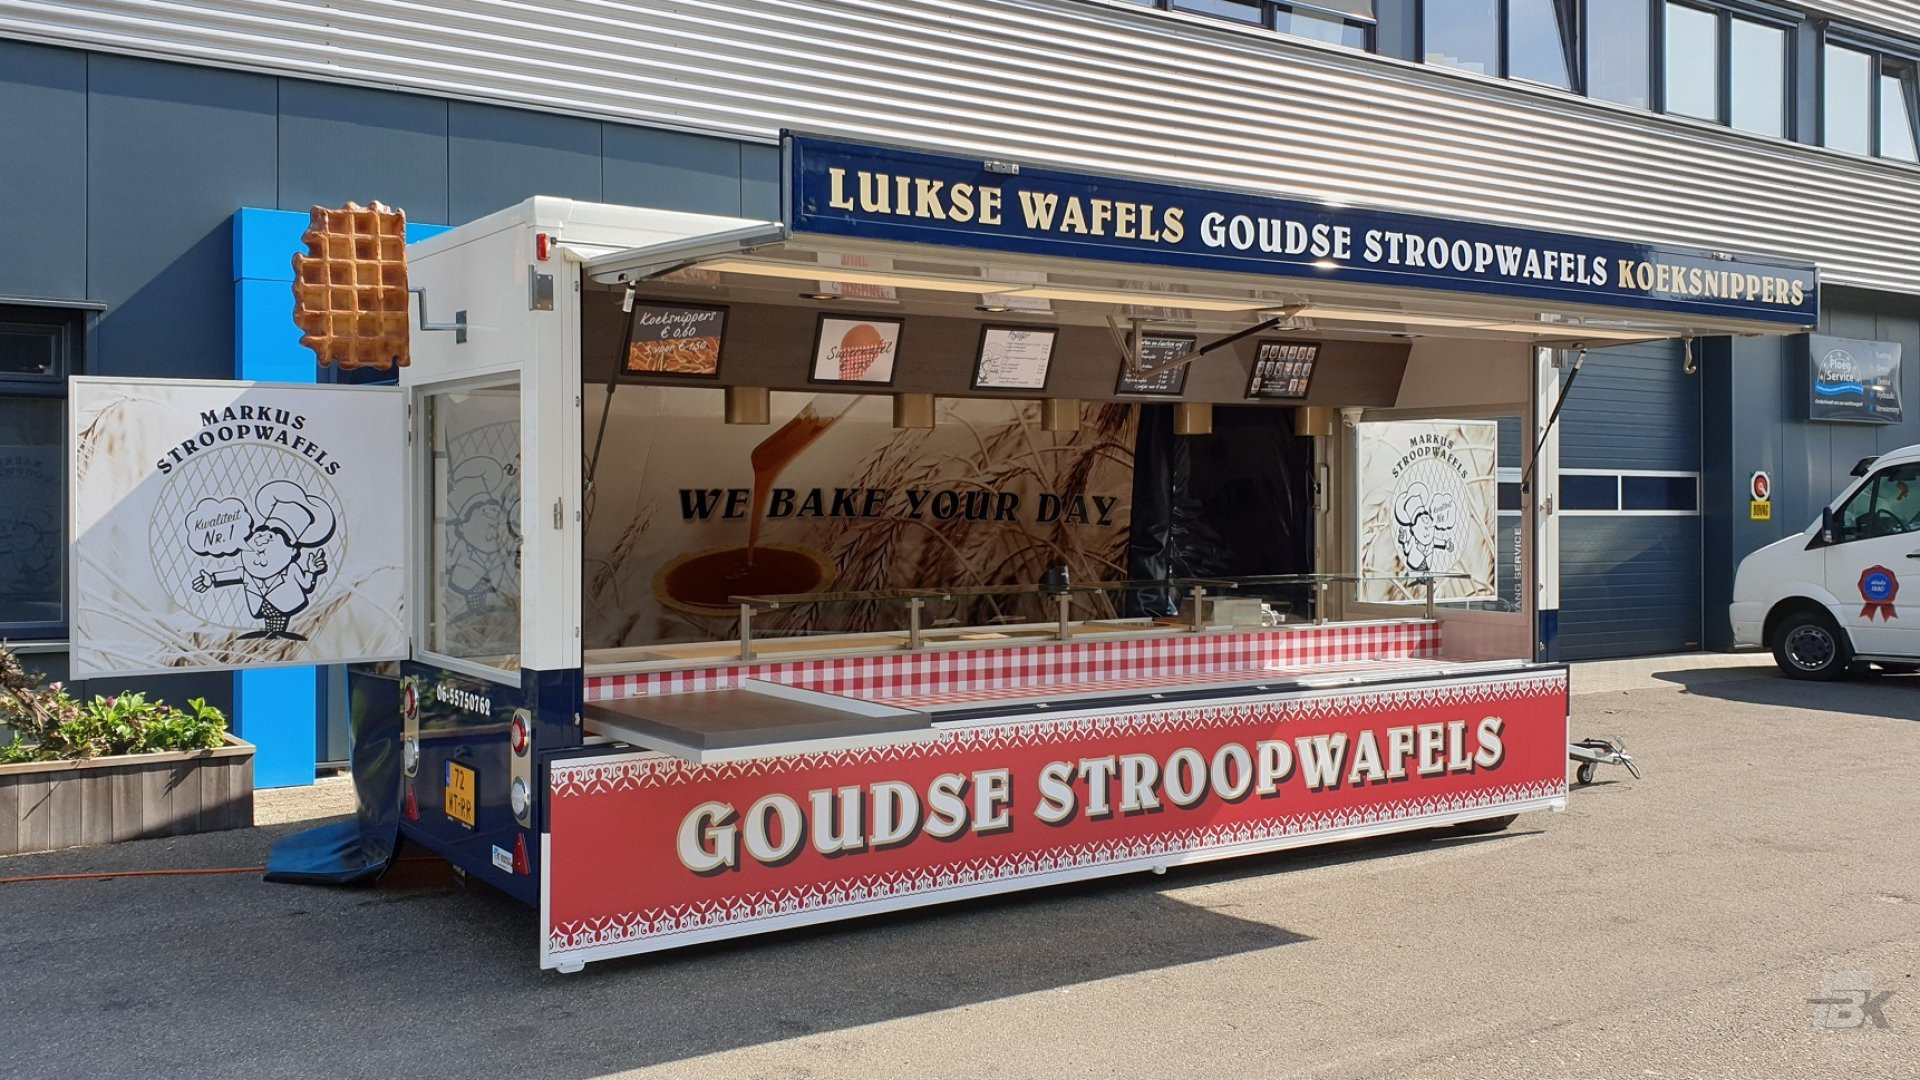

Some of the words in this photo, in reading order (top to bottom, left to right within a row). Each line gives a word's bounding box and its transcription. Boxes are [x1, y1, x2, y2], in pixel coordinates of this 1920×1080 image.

[828, 167, 1002, 225] LUIKSE
[1018, 190, 1185, 244] WAFELS
[1200, 212, 1351, 260] GOUDSE
[1363, 229, 1608, 286] STROOPWAFELS
[1617, 258, 1804, 306] KOEKSNIPPERS
[640, 311, 717, 327] Koeksnippers
[1826, 370, 1854, 382] Service
[1829, 358, 1851, 372] Ploeg
[200, 405, 306, 430] MARKUS
[156, 424, 341, 476] STROOPWAFELS
[1409, 434, 1455, 450] MARKUS
[1391, 446, 1468, 479] STROOPWAFELS
[194, 509, 242, 531] Kwaliteit
[678, 488, 751, 521] WE
[766, 487, 887, 520] BAKE
[900, 489, 1023, 523] YOUR
[1035, 492, 1120, 527] DAY
[1513, 527, 1522, 578] SERVICE
[436, 684, 491, 716] 06-55750762
[454, 768, 465, 790] 72
[676, 768, 1013, 876] GOUDSE
[1033, 716, 1505, 823] STROOPWAFELS
